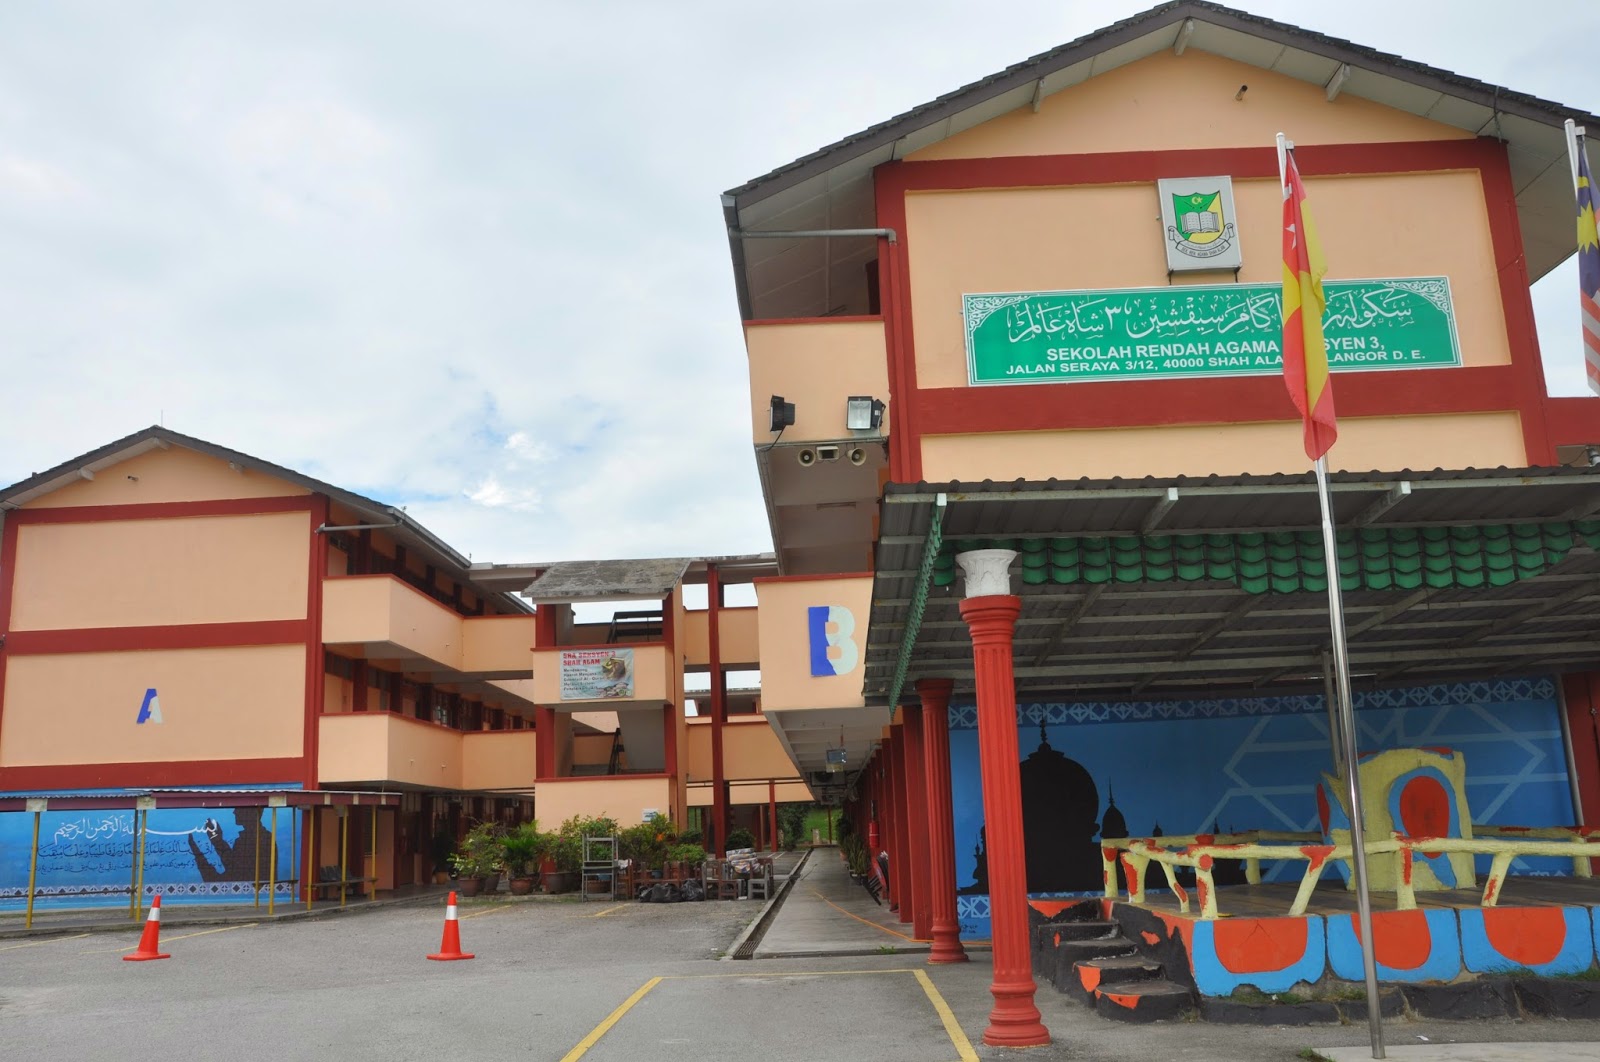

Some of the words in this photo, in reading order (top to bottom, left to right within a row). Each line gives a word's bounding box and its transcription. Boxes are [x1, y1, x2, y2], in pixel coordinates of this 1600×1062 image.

[1047, 346, 1132, 361] SEKOLAH
[1135, 342, 1209, 358] RENDAH
[1214, 340, 1280, 355] AGAMA
[1324, 336, 1366, 351] SYEN
[1369, 335, 1385, 351] 3,
[1006, 364, 1056, 375] JALAN
[1060, 361, 1120, 373] SERAYA
[1125, 360, 1158, 371] 3/12,
[1163, 357, 1204, 368] 40000
[1208, 356, 1250, 367] SHAH
[1254, 355, 1284, 366] ALA
[1392, 350, 1408, 360] D.
[1411, 349, 1426, 360] E.
[808, 605, 859, 677] B
[563, 659, 581, 667] SHAH
[582, 658, 601, 666] ALAM
[136, 688, 162, 724] A
